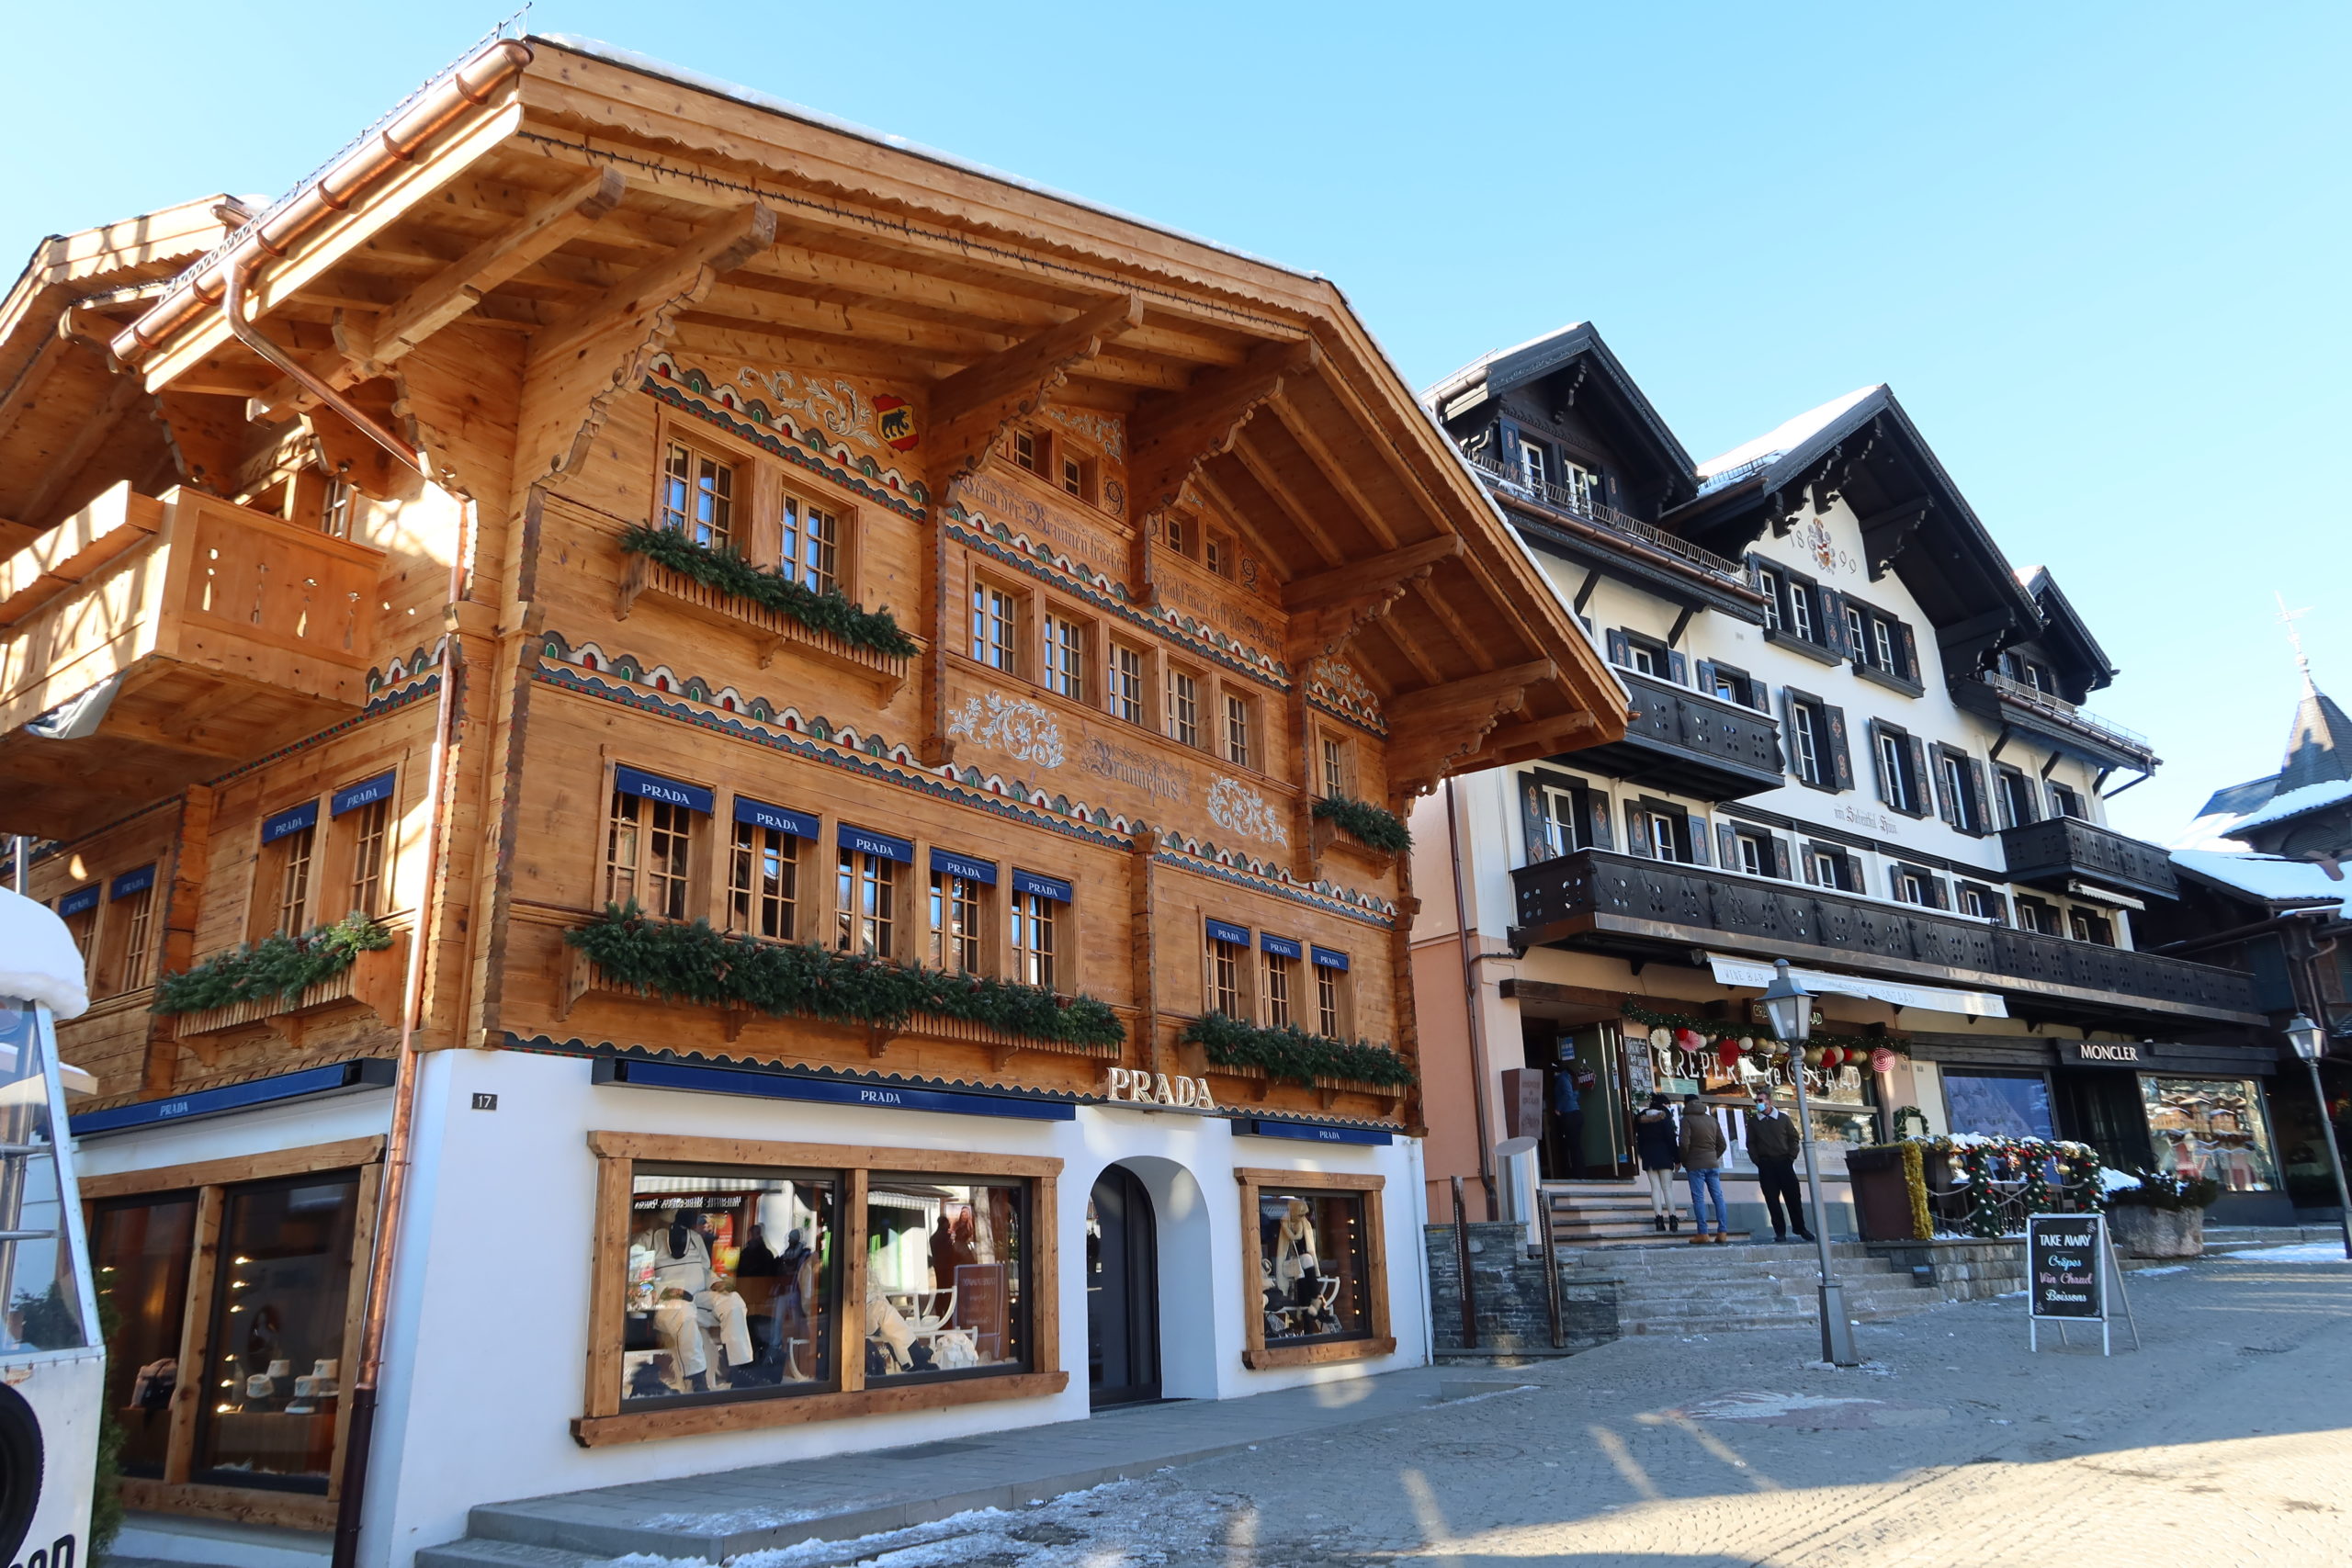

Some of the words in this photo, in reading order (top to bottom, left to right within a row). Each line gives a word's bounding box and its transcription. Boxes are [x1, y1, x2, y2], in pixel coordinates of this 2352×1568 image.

[346, 788, 378, 808] PRADA
[642, 784, 691, 806] PRADA
[276, 817, 302, 836] PRADA
[757, 812, 799, 833] PRADA
[855, 838, 895, 857] PRADA
[947, 861, 981, 879] PRADA
[1028, 881, 1059, 898] PRADA
[1217, 929, 1240, 942] PRADA
[1271, 942, 1292, 956] PRADA
[1320, 955, 1340, 967] PRADA
[2079, 1043, 2139, 1062] MONCLER
[1106, 1066, 1216, 1111] PRADA
[479, 1095, 492, 1109] 17
[861, 1089, 901, 1105] PRADA
[159, 1101, 189, 1117] PRADA
[1319, 1130, 1340, 1141] PRADA
[2039, 1235, 2063, 1247] TAKE
[2064, 1235, 2092, 1247] AWAY
[2039, 1271, 2057, 1284] Vin
[2060, 1271, 2093, 1285] Chaud
[2045, 1289, 2087, 1303] Boissons
